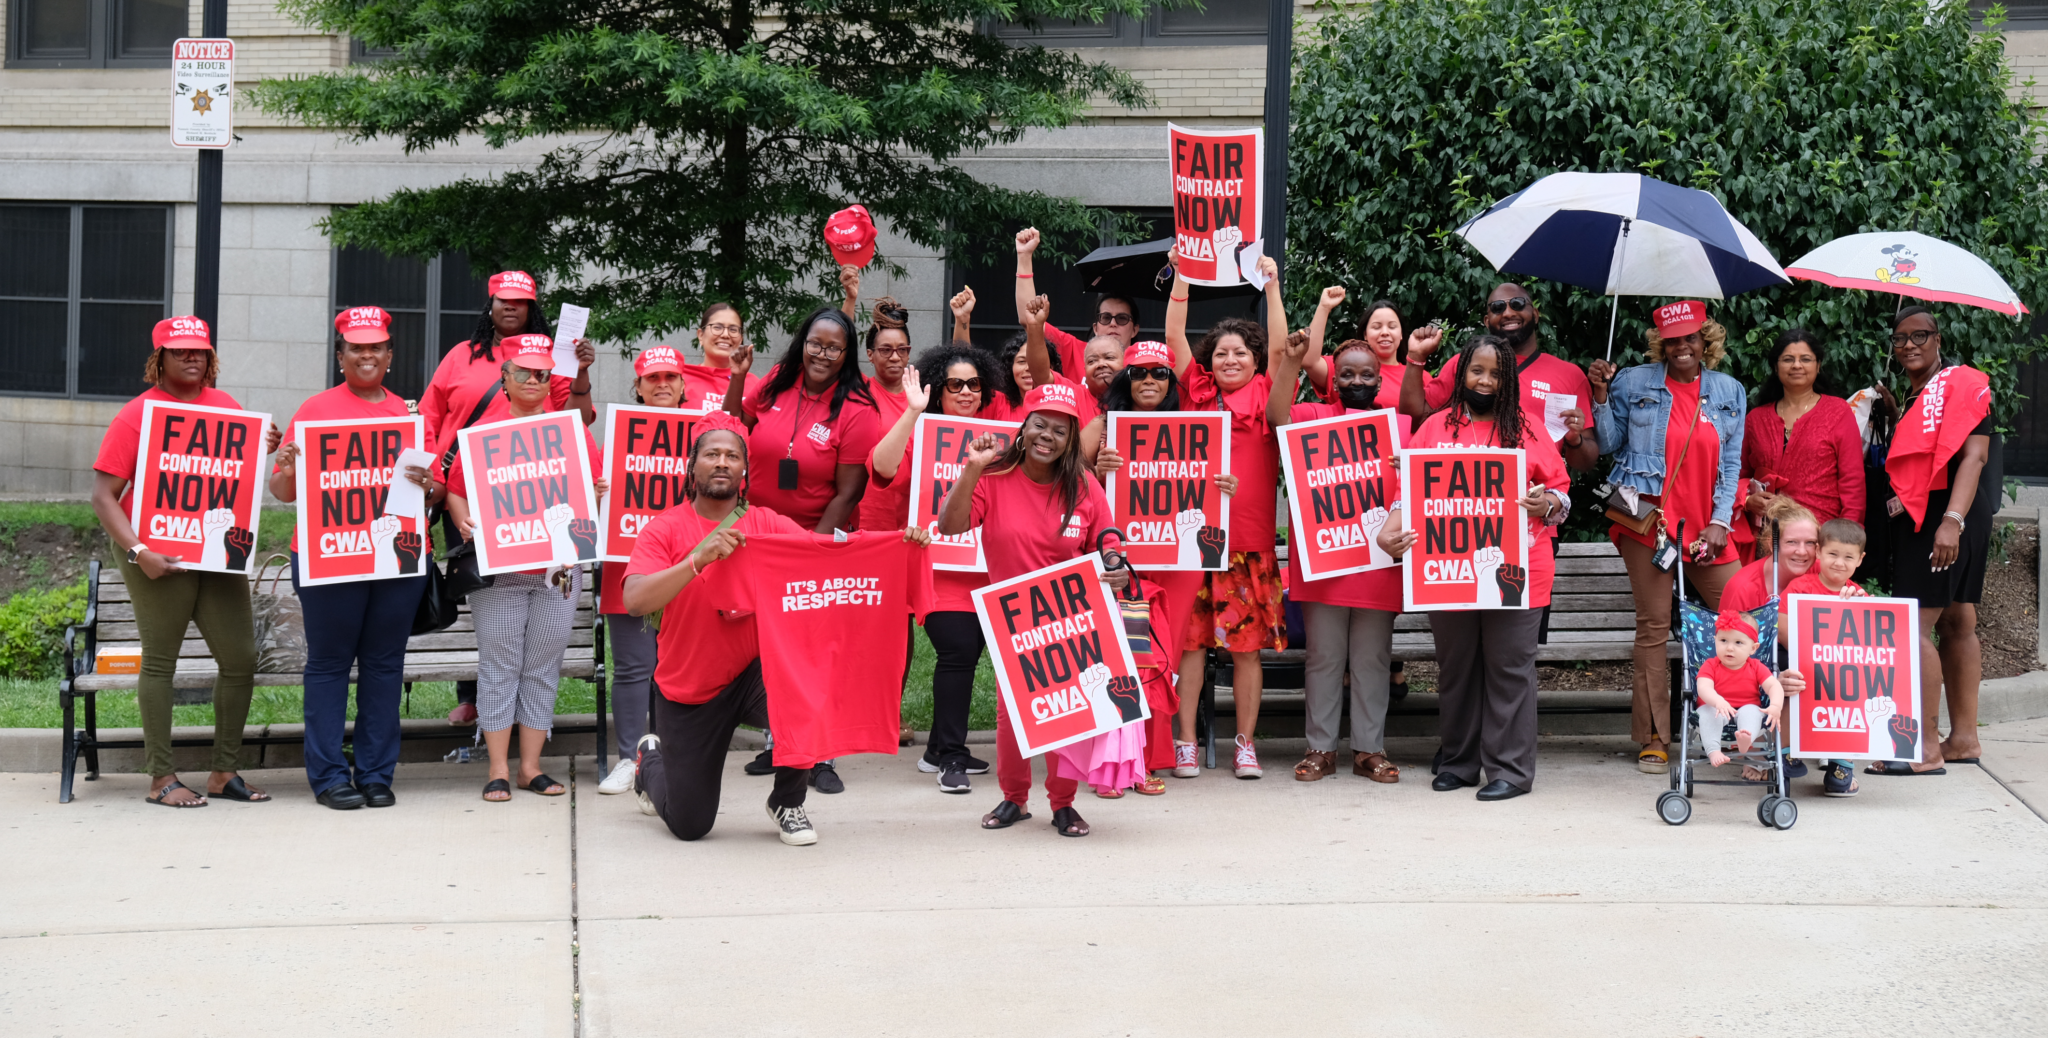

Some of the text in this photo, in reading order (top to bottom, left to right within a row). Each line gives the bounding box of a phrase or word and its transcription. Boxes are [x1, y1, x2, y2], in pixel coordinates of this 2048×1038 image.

[178, 42, 230, 59] NOTICE
[197, 62, 226, 70] HOUR
[1176, 138, 1243, 179] FAIR
[1176, 175, 1243, 196] CONTRACT
[1177, 193, 1242, 232] NOW
[1177, 233, 1214, 258] CWA
[350, 308, 381, 320] CWA
[1661, 303, 1691, 318] CWA
[172, 319, 204, 330] CWA
[520, 336, 550, 347] CWA
[645, 347, 675, 359] CWA
[1138, 341, 1168, 355] CWA
[1042, 384, 1075, 399] CWA
[1531, 380, 1551, 392] CWA
[162, 415, 247, 460] FAIR
[810, 422, 831, 438] CWA
[1130, 424, 1209, 460] FAIR
[320, 430, 401, 471] FAIR
[482, 424, 565, 469] FAIR
[1301, 423, 1380, 470] FAIR
[159, 452, 243, 478] CONTRACT
[320, 467, 396, 489] CONTRAC
[486, 457, 566, 485] CONTRACT
[1129, 461, 1208, 478] CONTRACT
[1307, 459, 1381, 487] CONTRACT
[155, 472, 240, 513] NOW
[1424, 461, 1504, 498] FAIR
[491, 475, 569, 519] NOW
[1129, 480, 1206, 516] NOW
[1311, 477, 1385, 524] NOW
[1424, 498, 1505, 516] CONTRACT
[149, 514, 203, 543] CWA
[495, 519, 549, 546] CWA
[1126, 521, 1176, 543] CWA
[1316, 523, 1366, 550] CWA
[1425, 517, 1504, 554] NOW
[320, 530, 373, 557] CWA
[1424, 560, 1475, 582] CWA
[786, 577, 879, 594] IT'S ABOUT
[782, 590, 883, 612] RESPECT!
[999, 572, 1092, 635] FAIR
[1011, 610, 1096, 654] CONTRACT
[1812, 607, 1895, 647] FAIR
[1018, 630, 1104, 693] NOW
[1812, 644, 1896, 665] CONTRACT
[1814, 663, 1895, 702] NOW
[1031, 685, 1088, 722] CWA
[1812, 706, 1866, 730] CWA
